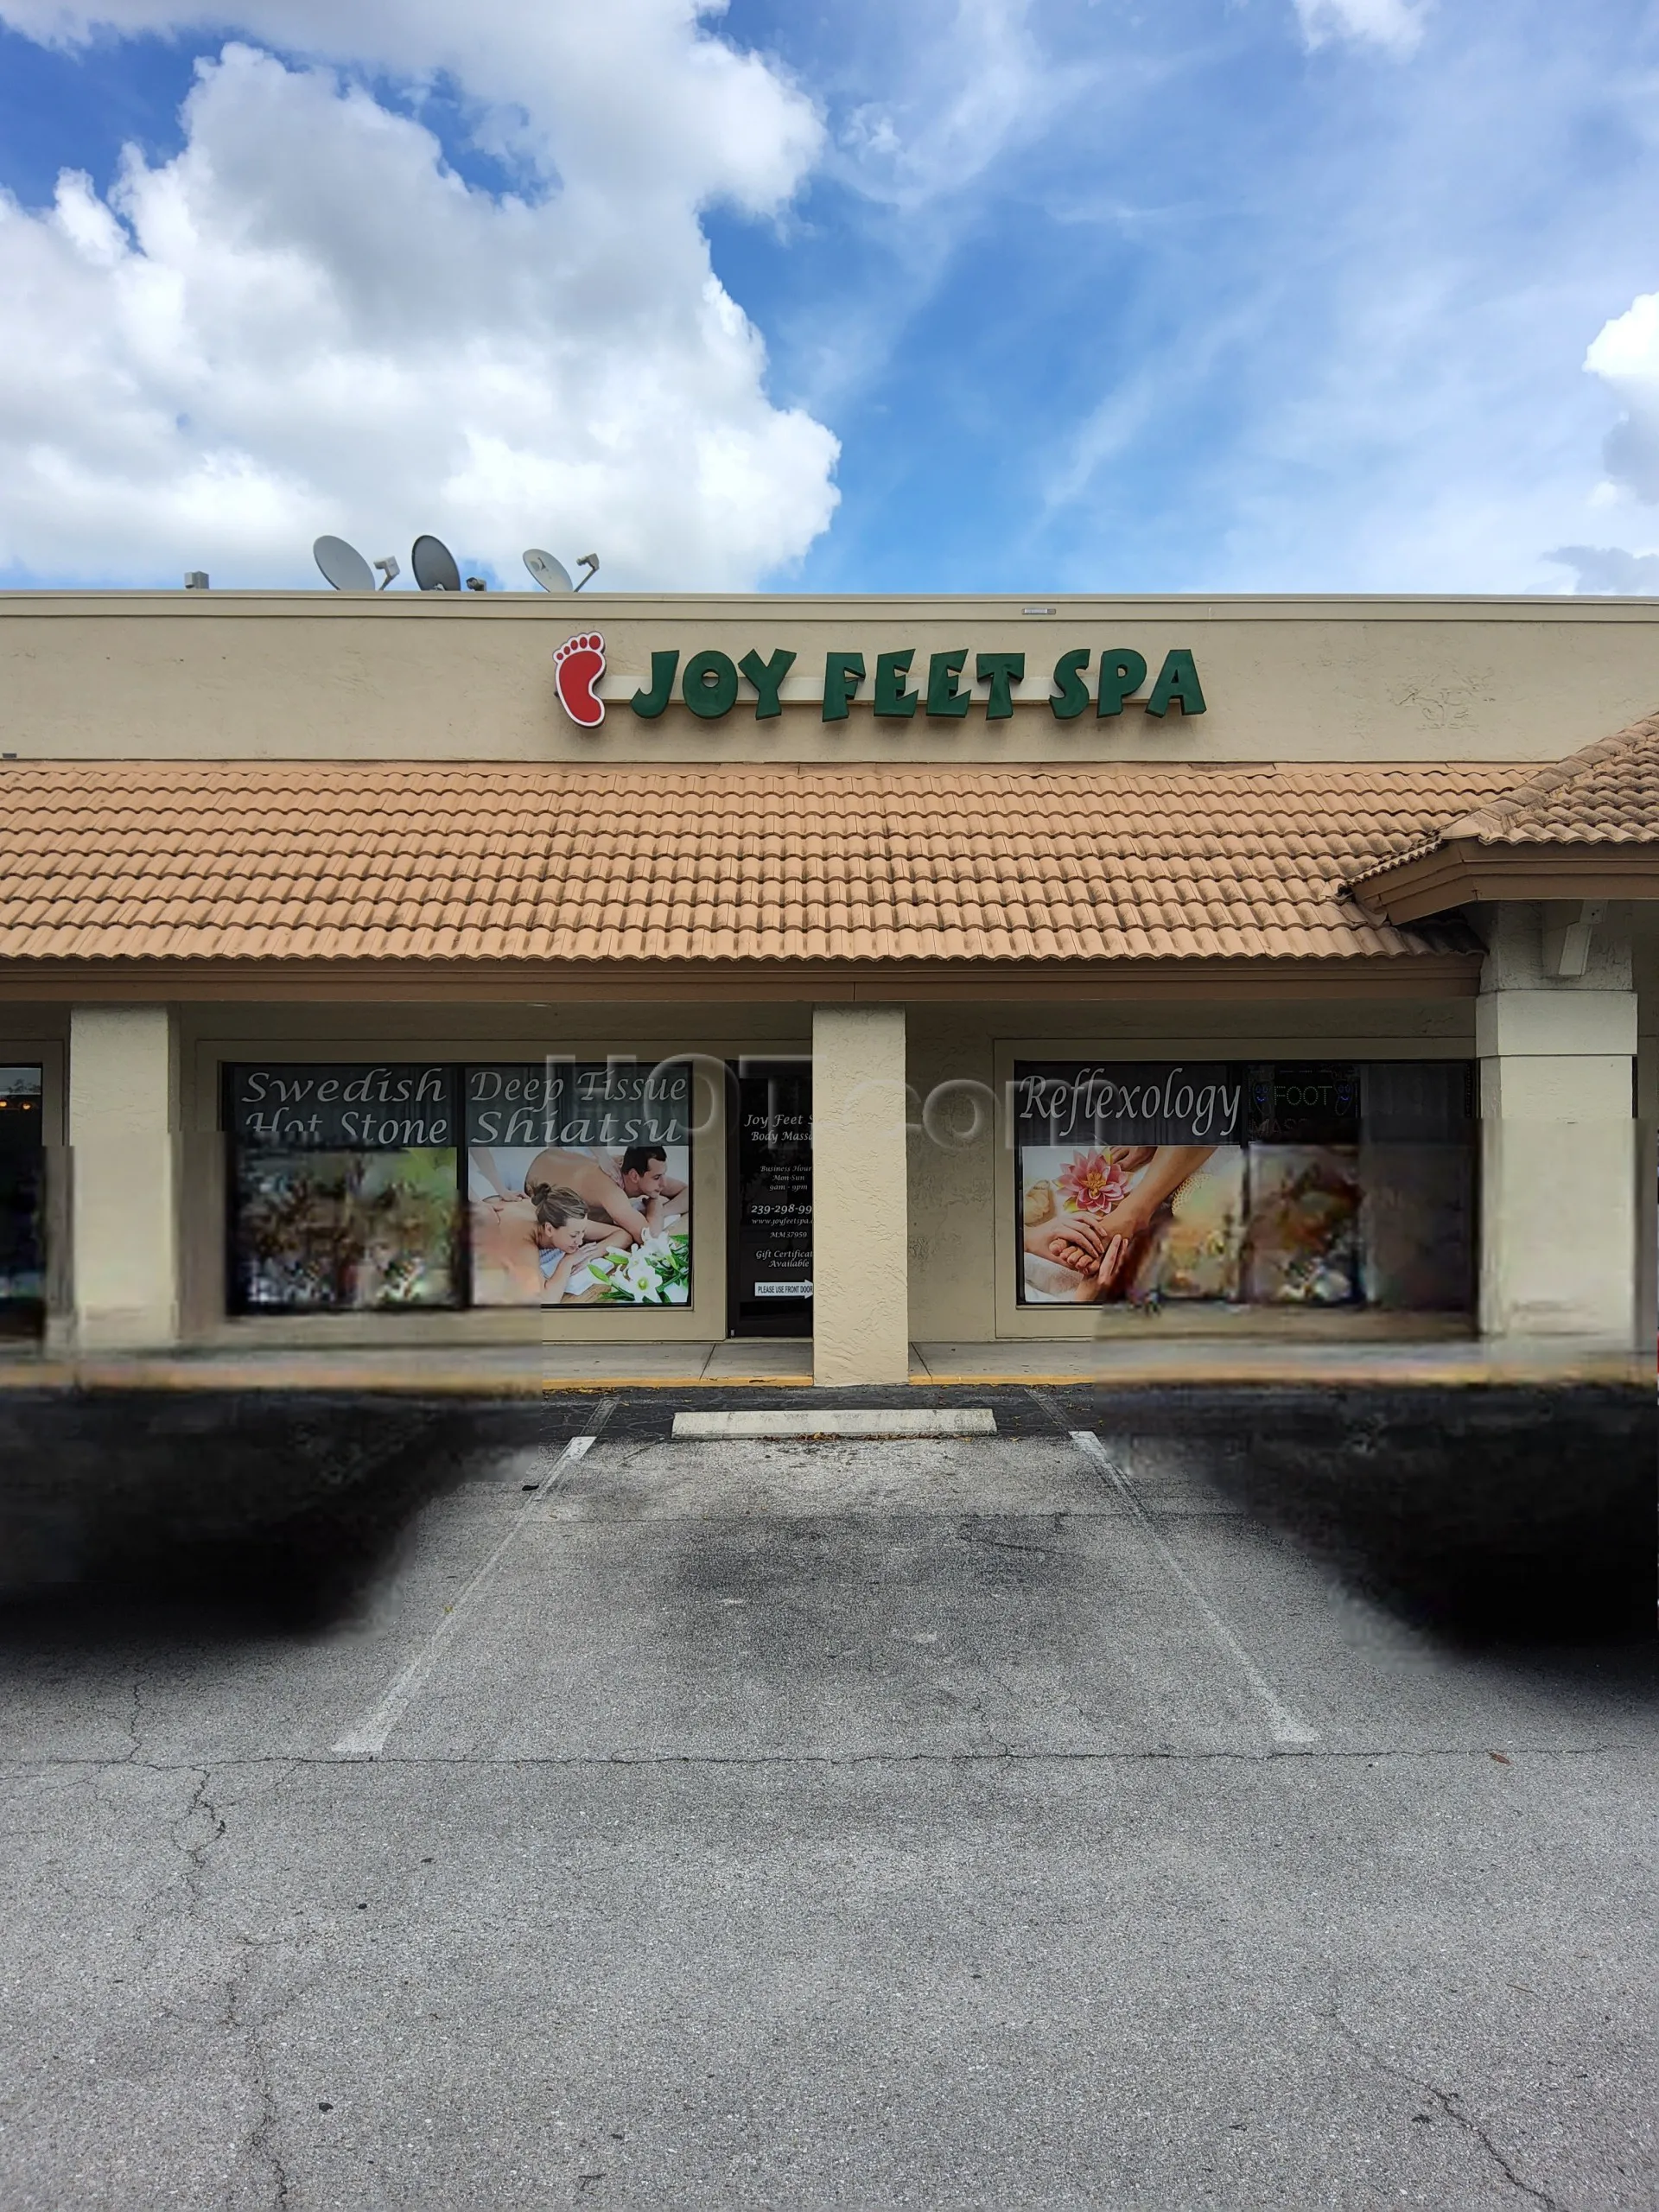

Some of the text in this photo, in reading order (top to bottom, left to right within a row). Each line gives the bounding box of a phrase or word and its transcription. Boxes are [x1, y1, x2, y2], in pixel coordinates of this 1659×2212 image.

[630, 648, 1207, 722] JOY FEET SPA
[241, 1067, 448, 1103] Swedish
[470, 1068, 687, 1109] Deep Tissue
[1274, 1085, 1333, 1106] FOOT
[1018, 1068, 1242, 1136] Reflexology
[340, 1111, 448, 1144] Stone
[471, 1108, 682, 1145] Shiatsu
[743, 1114, 769, 1129] Joy
[772, 1114, 804, 1128] Feet
[751, 1130, 779, 1144] Body
[750, 1203, 812, 1214] 239-298-99
[755, 1249, 772, 1260] Gift
[768, 1259, 810, 1268] Available
[757, 1285, 813, 1294] PLEASE USE FRONT DOOR
